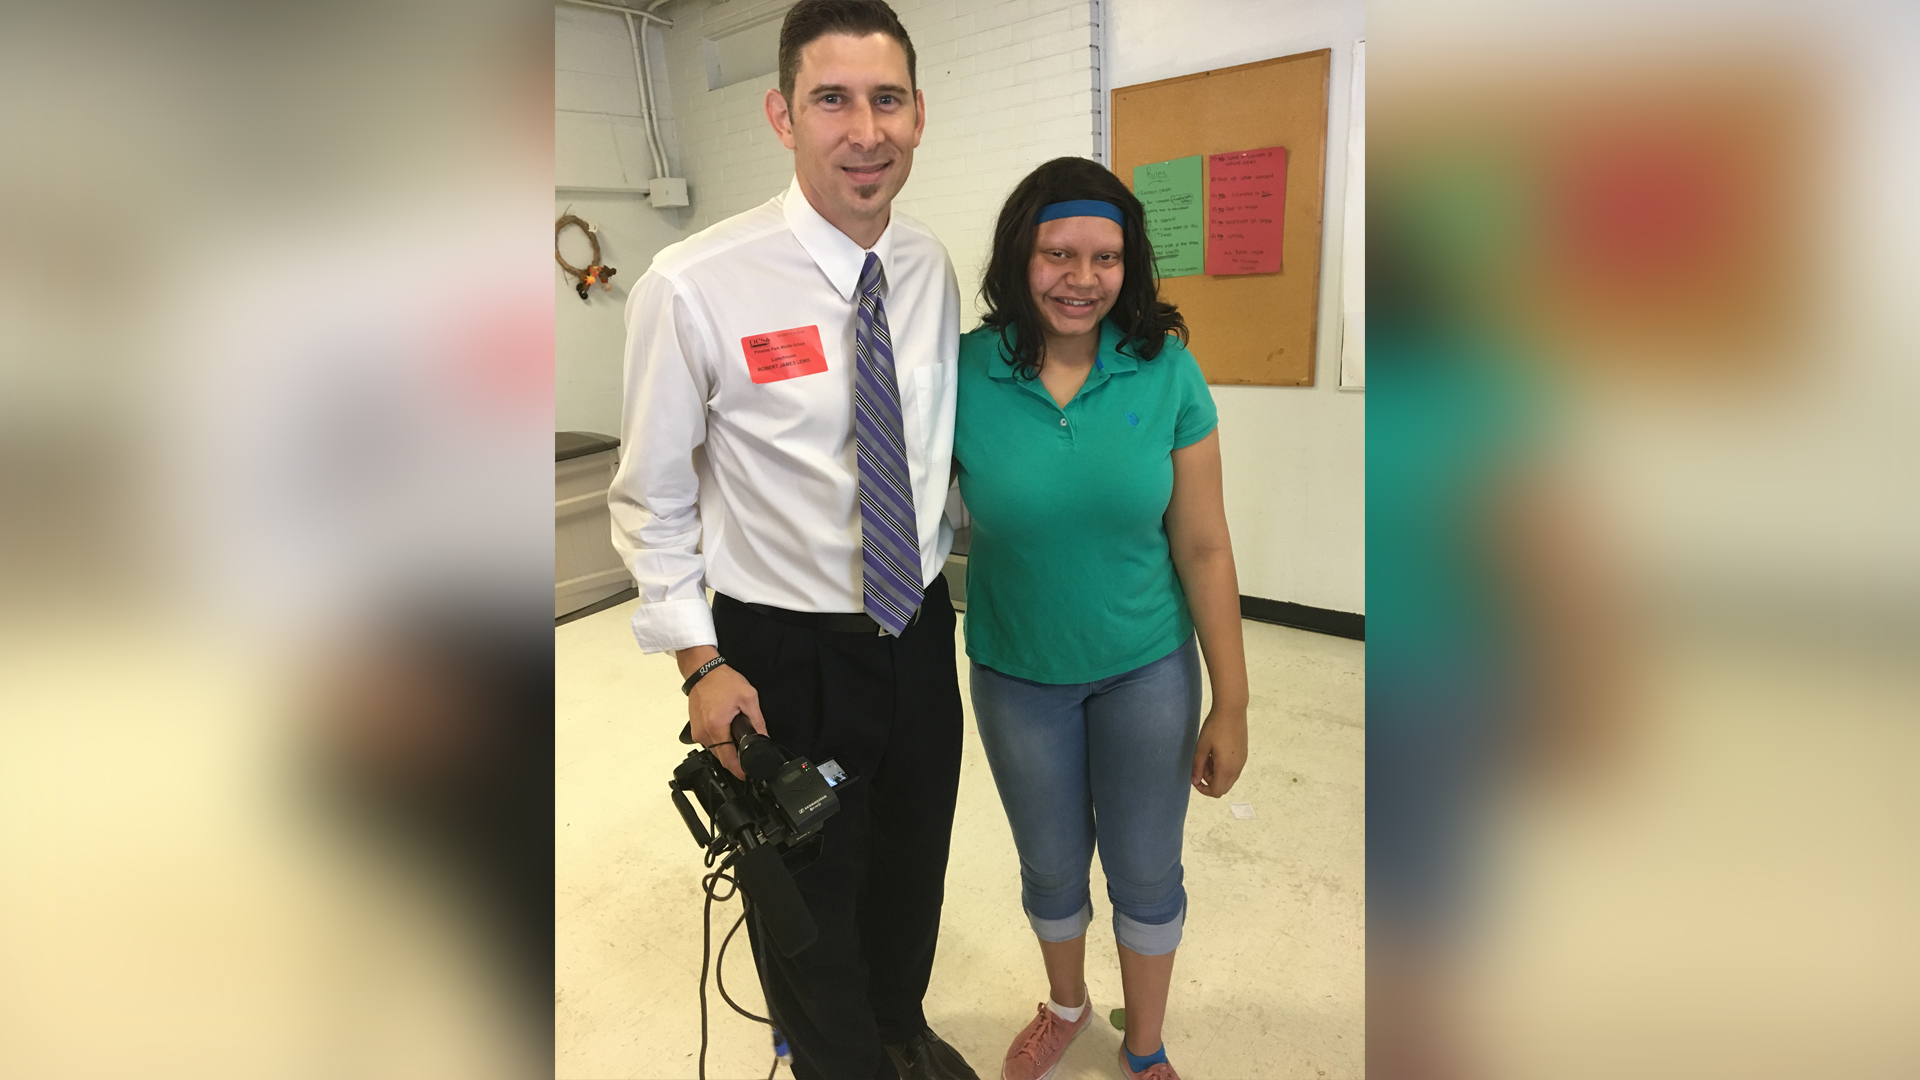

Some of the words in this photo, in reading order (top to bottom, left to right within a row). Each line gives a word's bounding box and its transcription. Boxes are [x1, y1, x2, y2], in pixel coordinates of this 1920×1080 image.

[1146, 167, 1167, 180] Rules
[771, 354, 797, 362] Lunchroom
[757, 364, 779, 372] ROBERT
